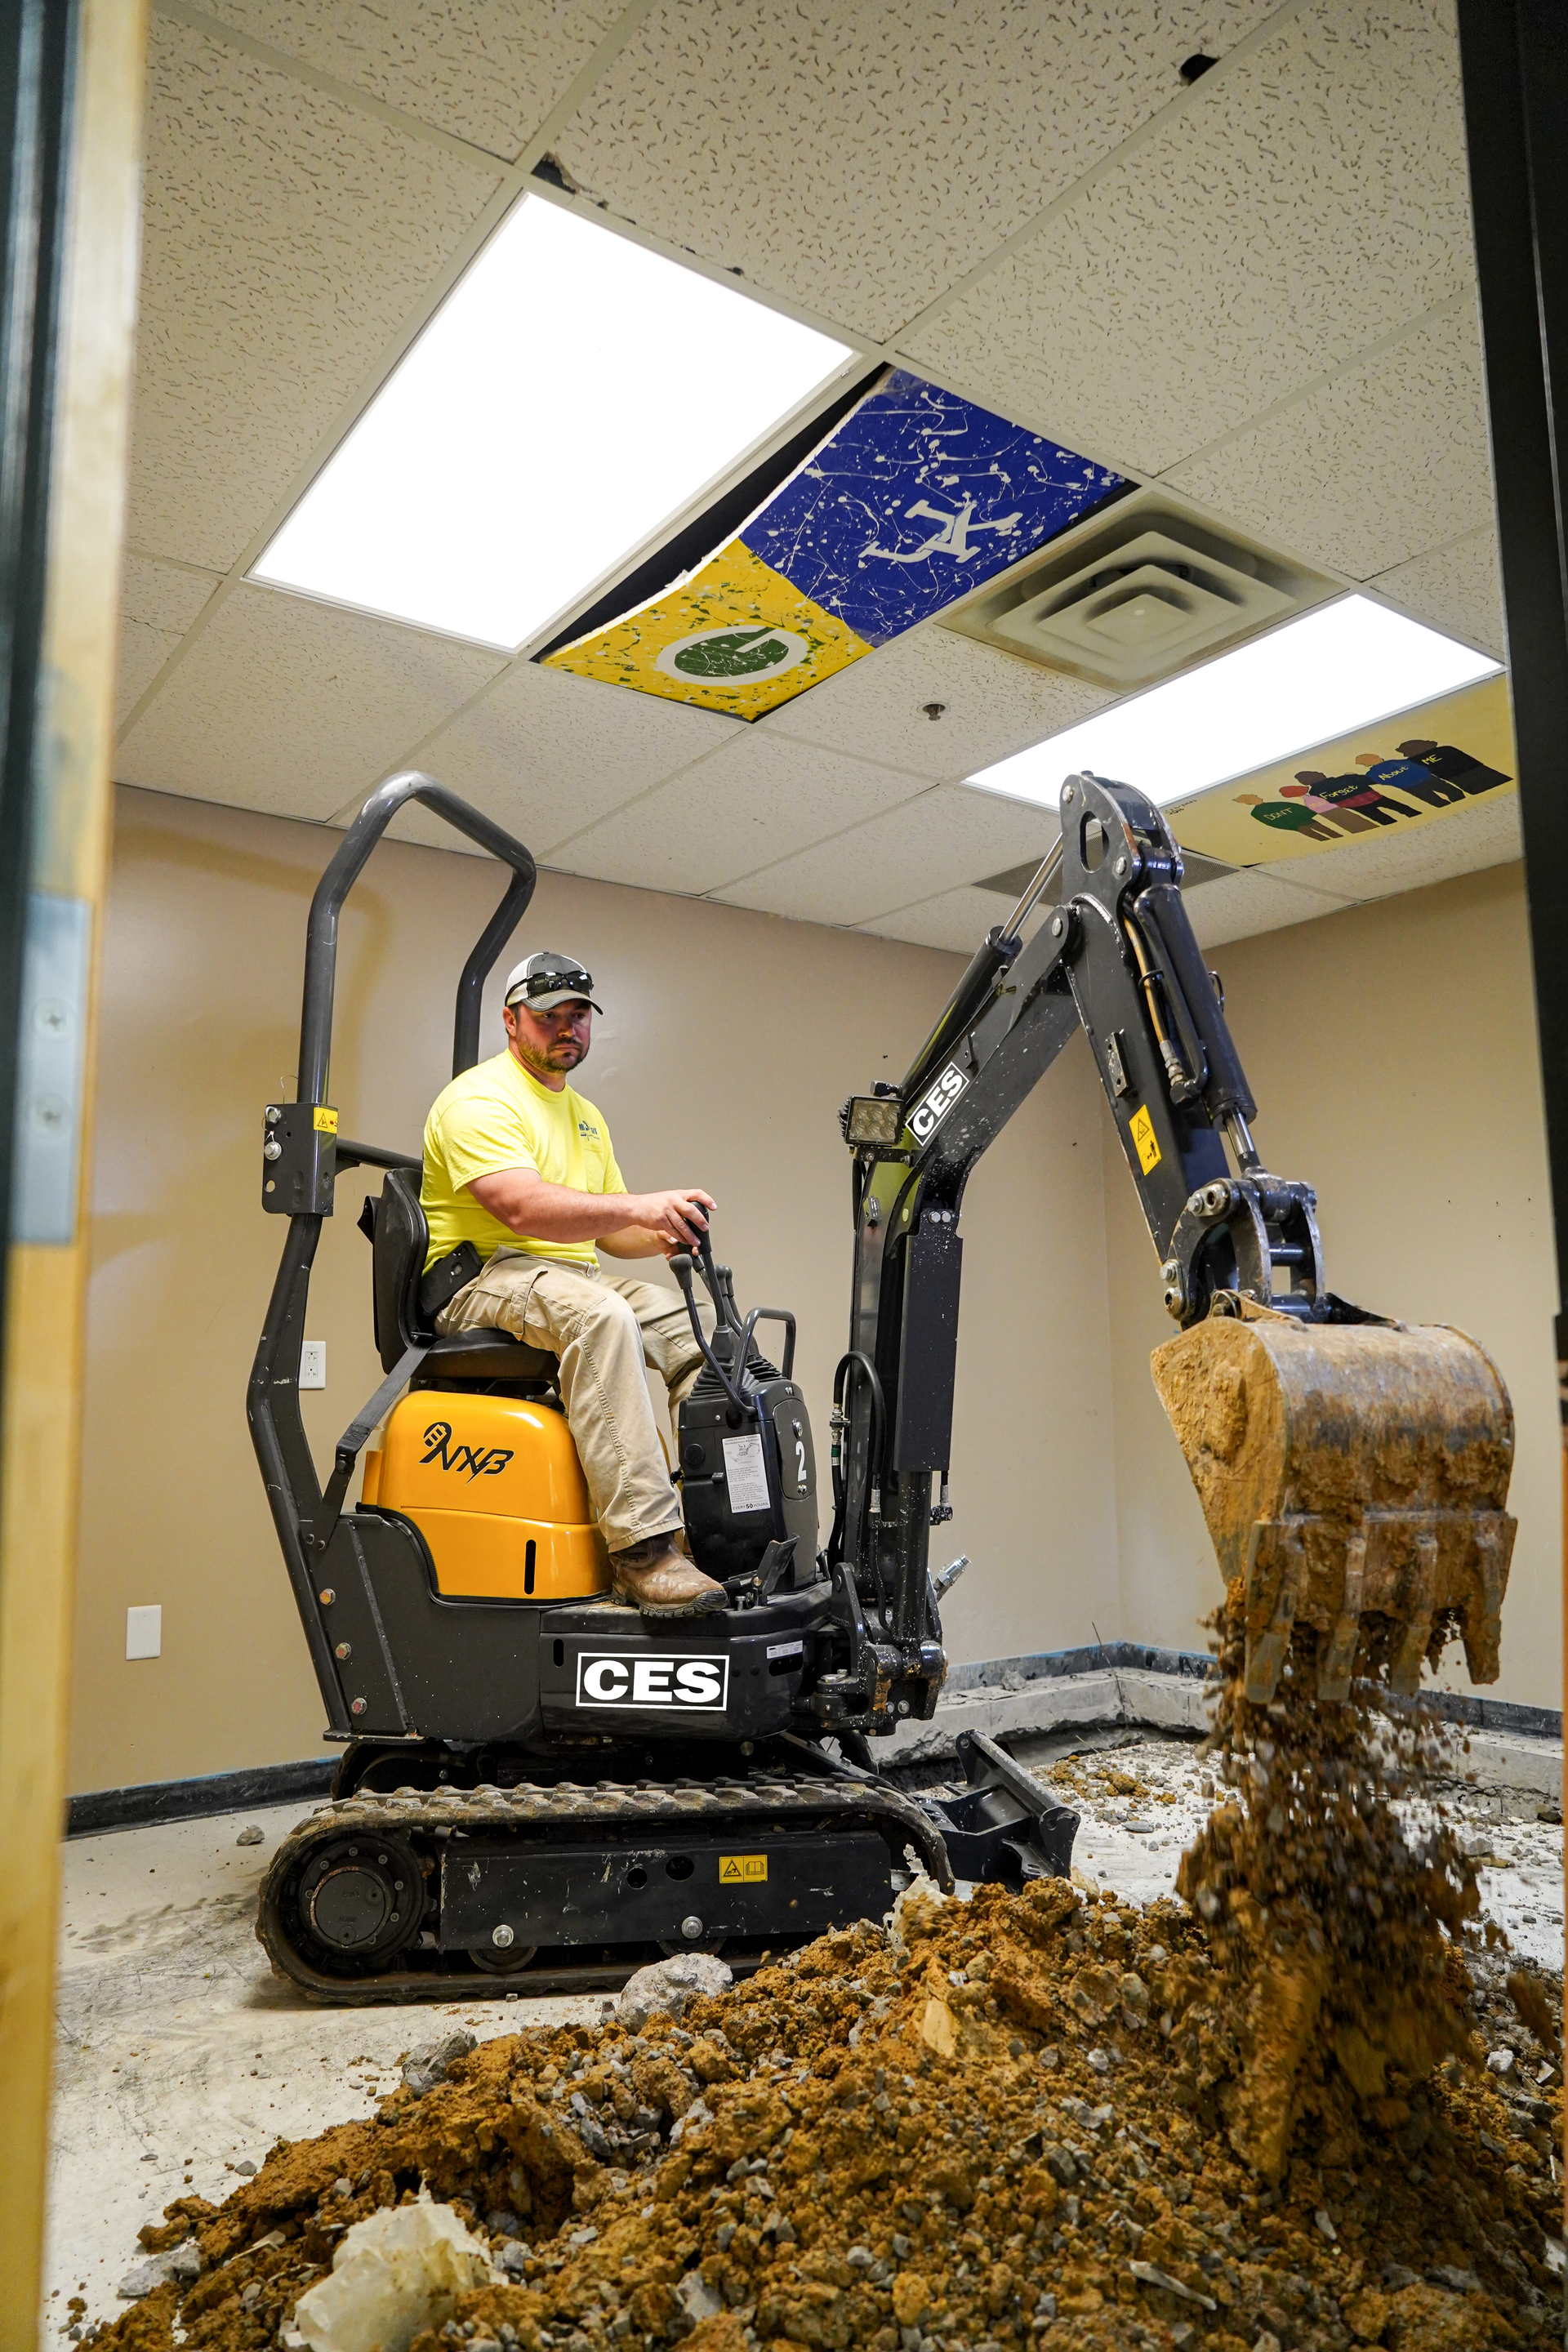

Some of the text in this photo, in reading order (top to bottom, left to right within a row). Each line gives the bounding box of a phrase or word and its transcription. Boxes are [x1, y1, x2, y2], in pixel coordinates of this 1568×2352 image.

[656, 625, 809, 687] G
[1319, 786, 1357, 800] Forget
[1378, 766, 1409, 781] About
[1421, 754, 1442, 765] ME
[913, 1069, 963, 1136] CES
[795, 1441, 807, 1481] 2
[583, 1659, 721, 1703] CES
